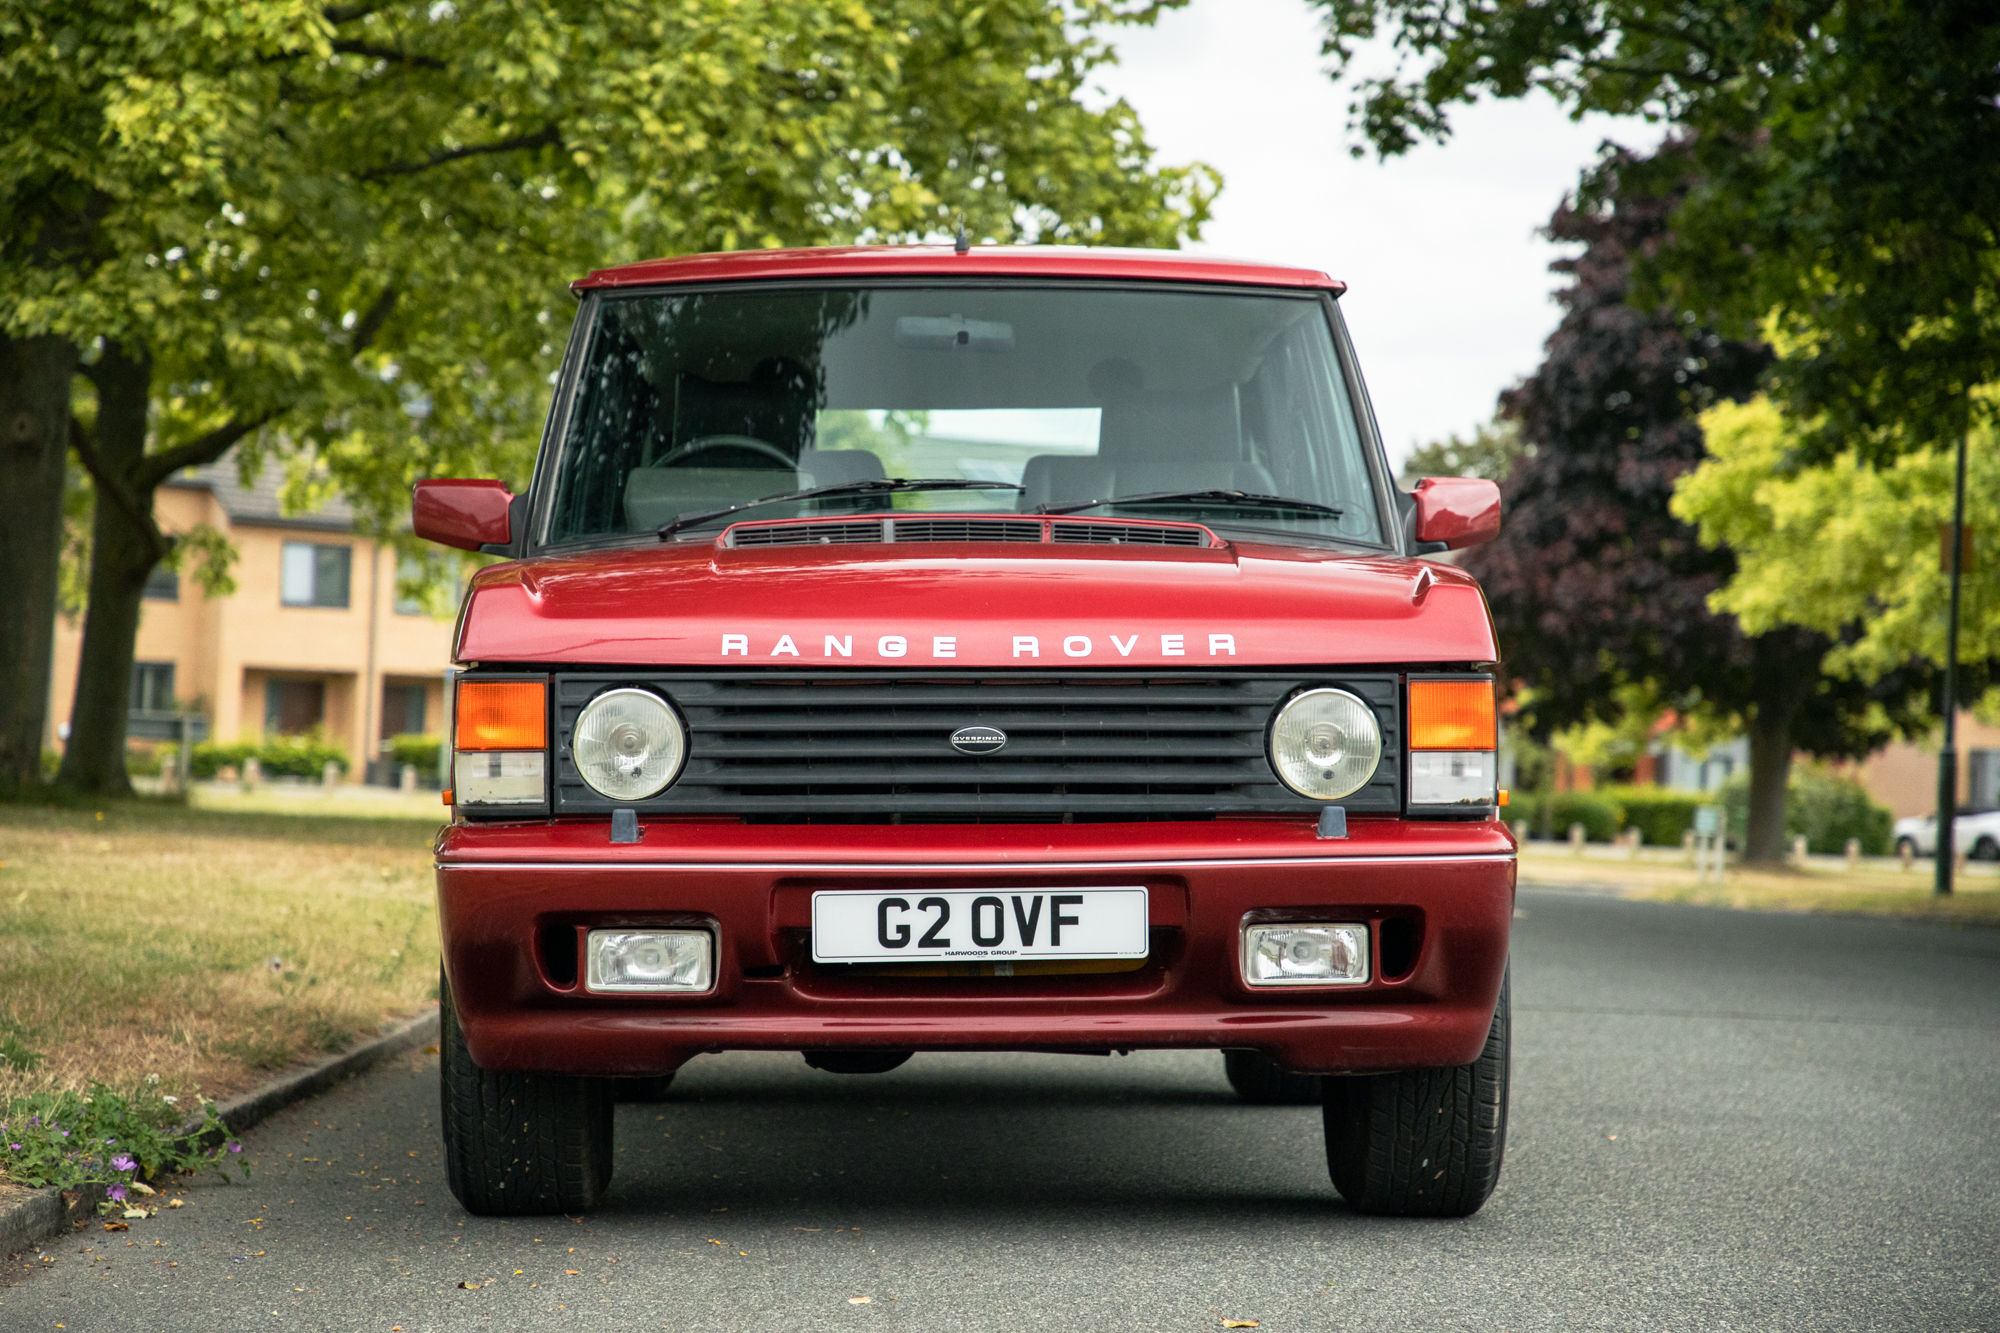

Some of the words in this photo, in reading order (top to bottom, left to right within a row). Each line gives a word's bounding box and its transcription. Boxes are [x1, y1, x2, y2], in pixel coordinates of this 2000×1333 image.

[721, 634, 957, 657] RANGE
[1012, 633, 1236, 657] ROVER
[877, 896, 951, 949] G2
[971, 895, 1083, 948] OVF
